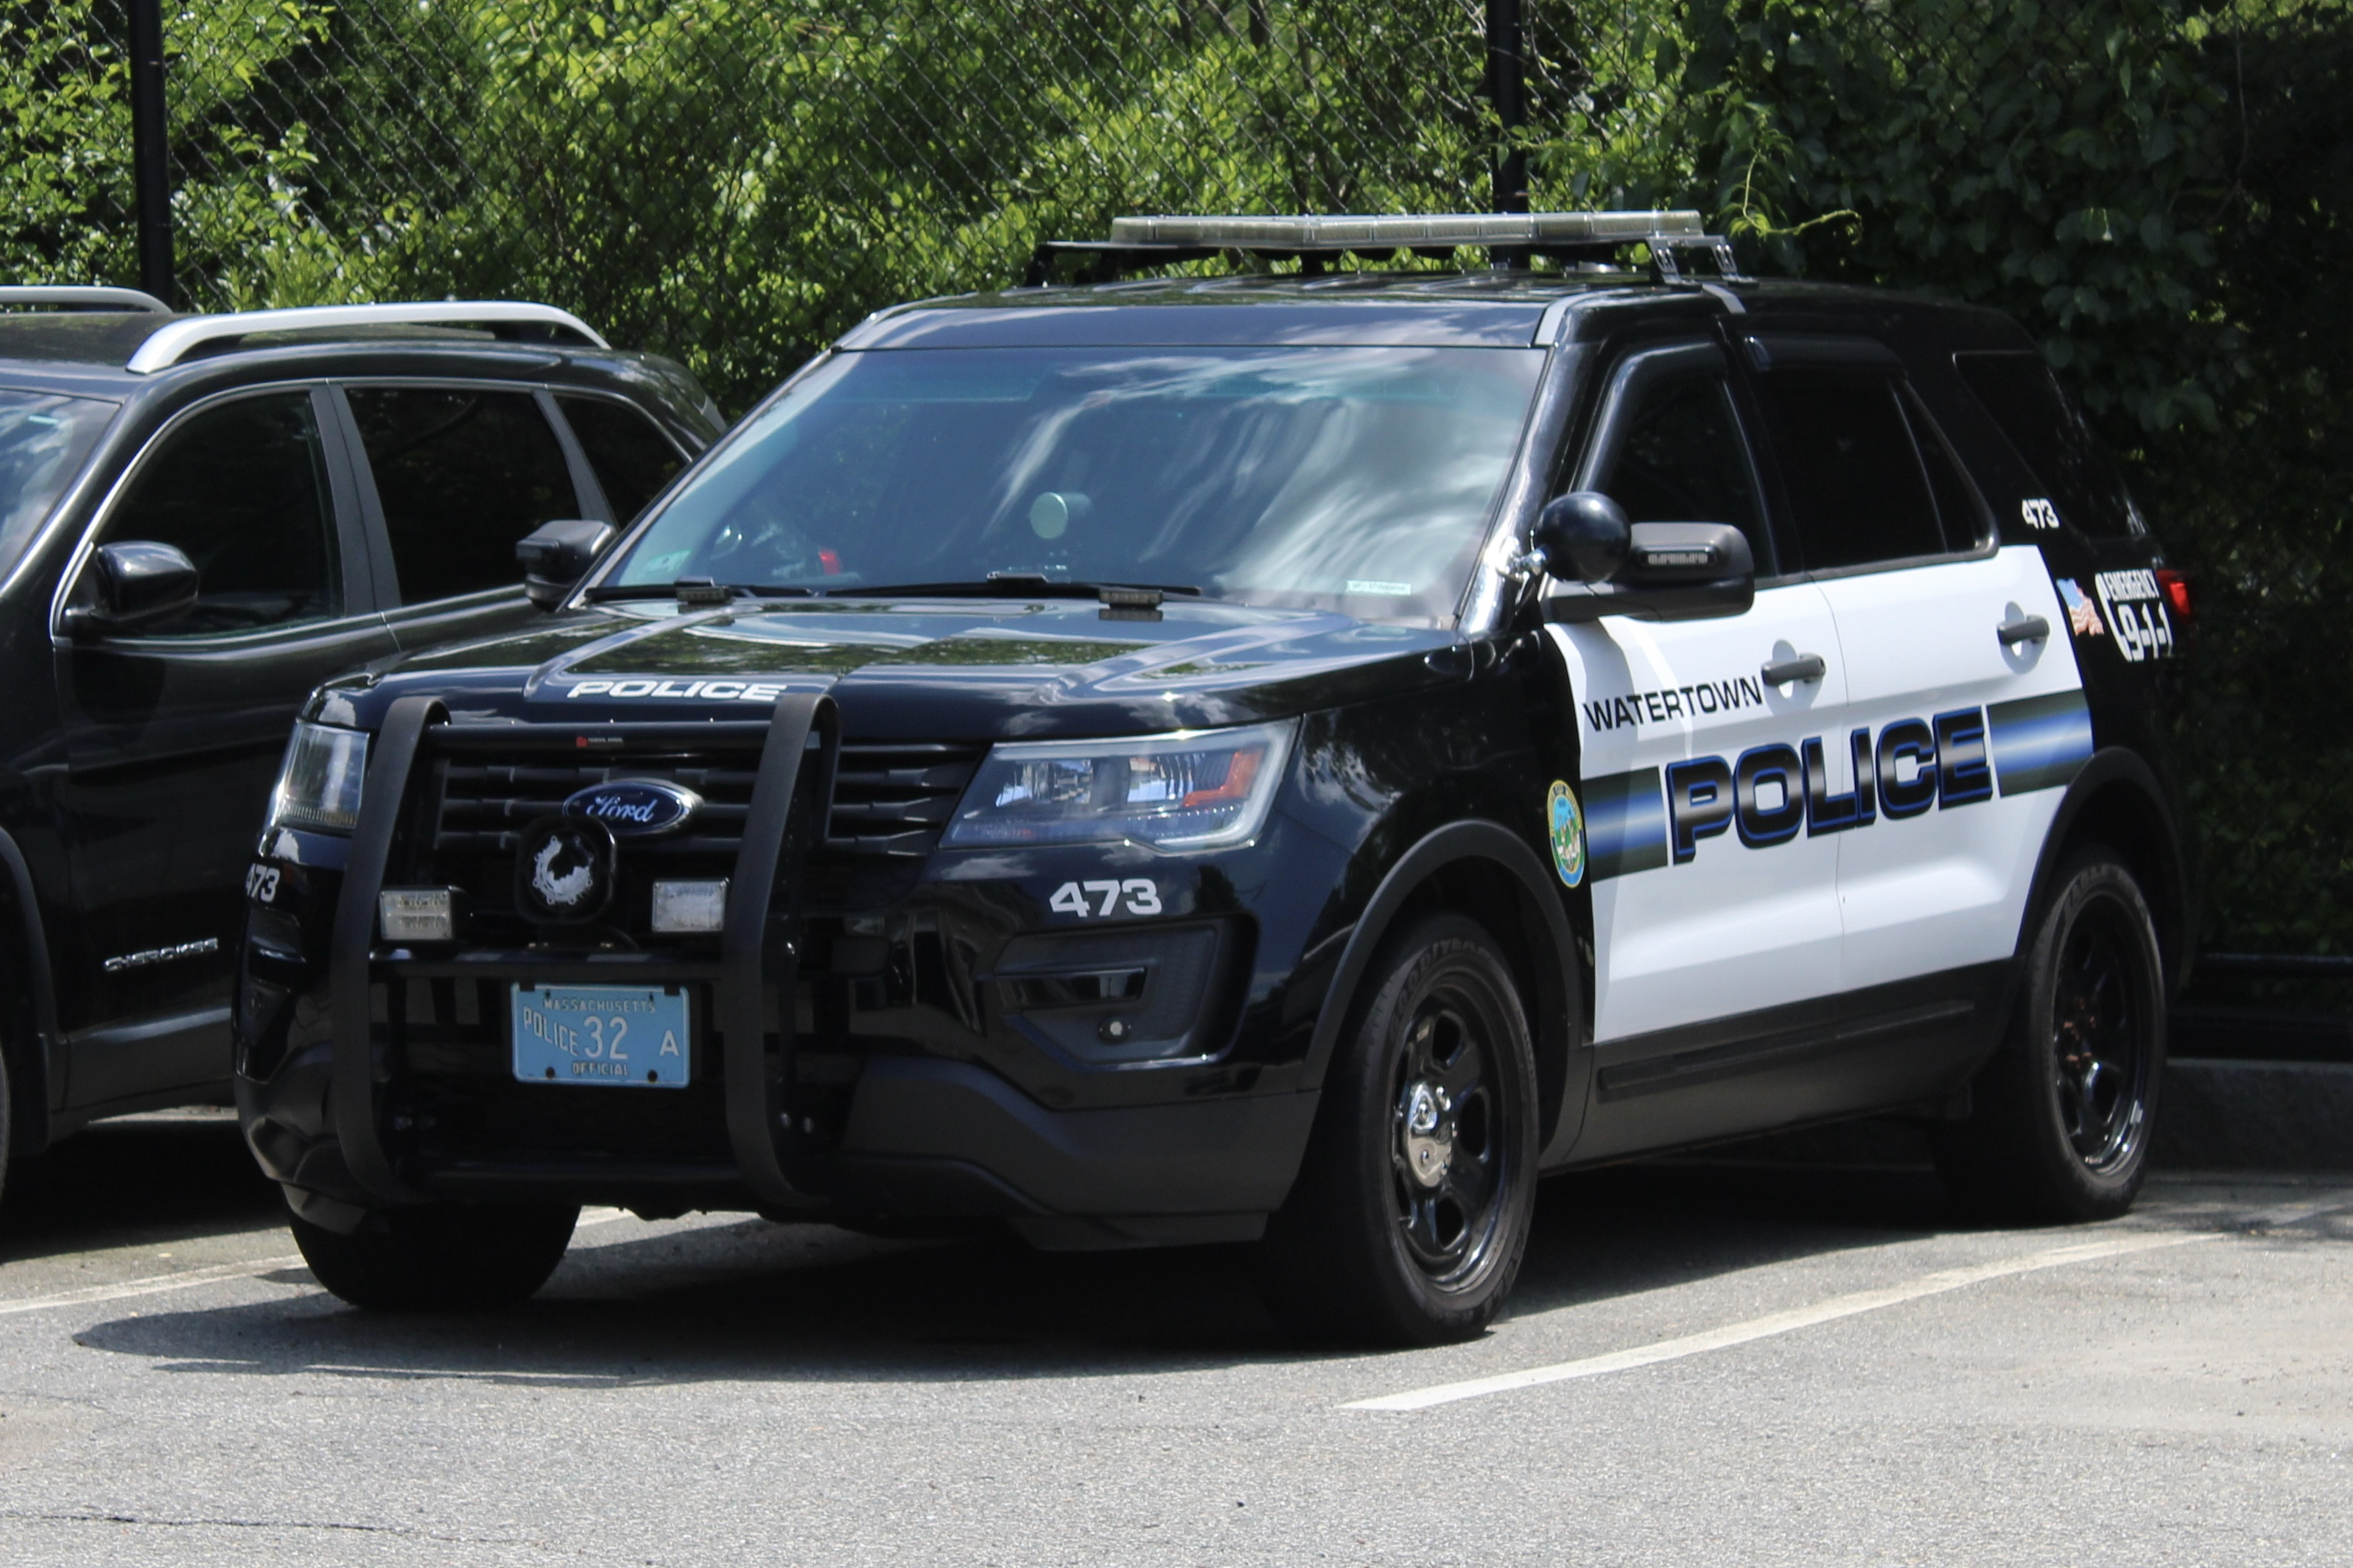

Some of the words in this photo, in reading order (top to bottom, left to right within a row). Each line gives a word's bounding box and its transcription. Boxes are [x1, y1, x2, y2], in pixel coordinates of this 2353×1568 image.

[2021, 499, 2060, 529] 473
[2103, 569, 2159, 602] EMERGENCY
[567, 681, 788, 701] POLICE
[1583, 675, 1763, 732] WATERTOWN
[1665, 706, 1993, 865] POLICE
[586, 794, 659, 823] Ford
[245, 863, 281, 902] 473
[1049, 878, 1163, 918] 473
[544, 998, 656, 1014] MASSACHUSETTS
[523, 1005, 578, 1057] POLICE
[583, 1016, 628, 1059] 32
[659, 1030, 680, 1057] A
[572, 1061, 629, 1076] OFFICIAL
